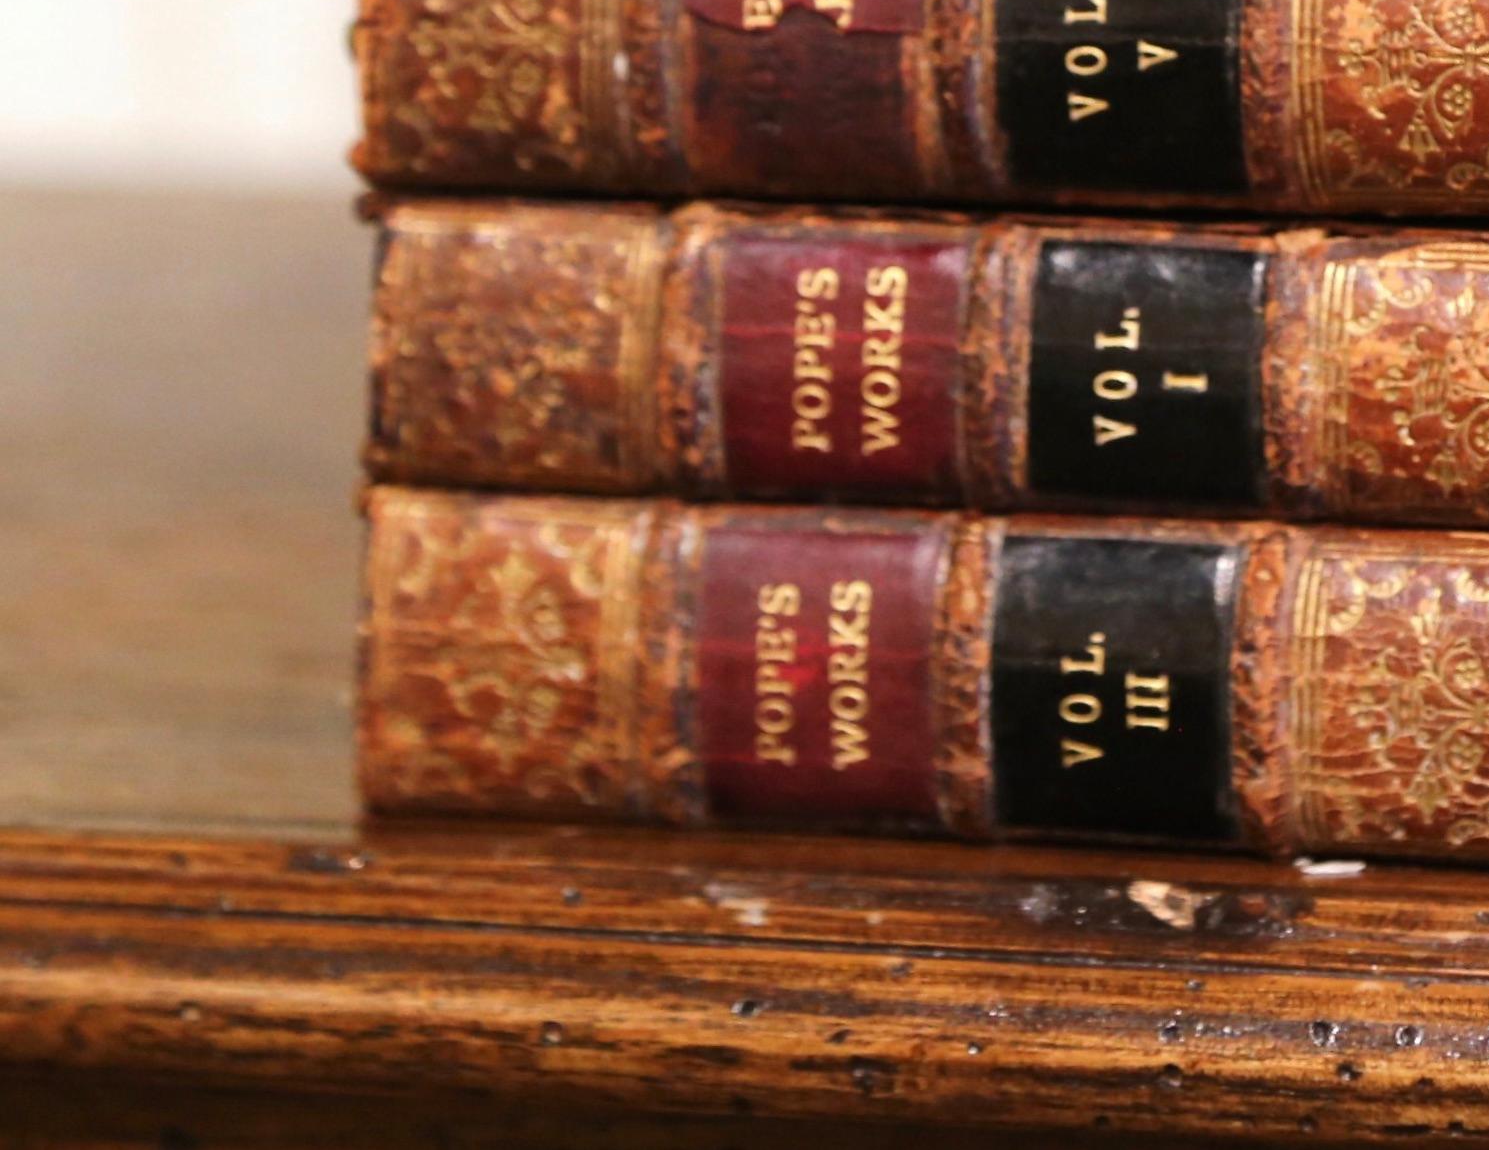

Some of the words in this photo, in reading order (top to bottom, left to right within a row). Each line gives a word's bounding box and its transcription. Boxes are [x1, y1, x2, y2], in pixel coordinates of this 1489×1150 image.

[1137, 40, 1178, 71] V
[792, 267, 839, 453] POPE'S
[861, 264, 909, 456] WORKS
[1093, 307, 1141, 446] VOL.
[1163, 371, 1208, 393] I
[755, 582, 799, 767] POPE'S
[827, 580, 872, 770] WORKS
[1059, 632, 1105, 768] VOL.
[1125, 672, 1170, 731] III
